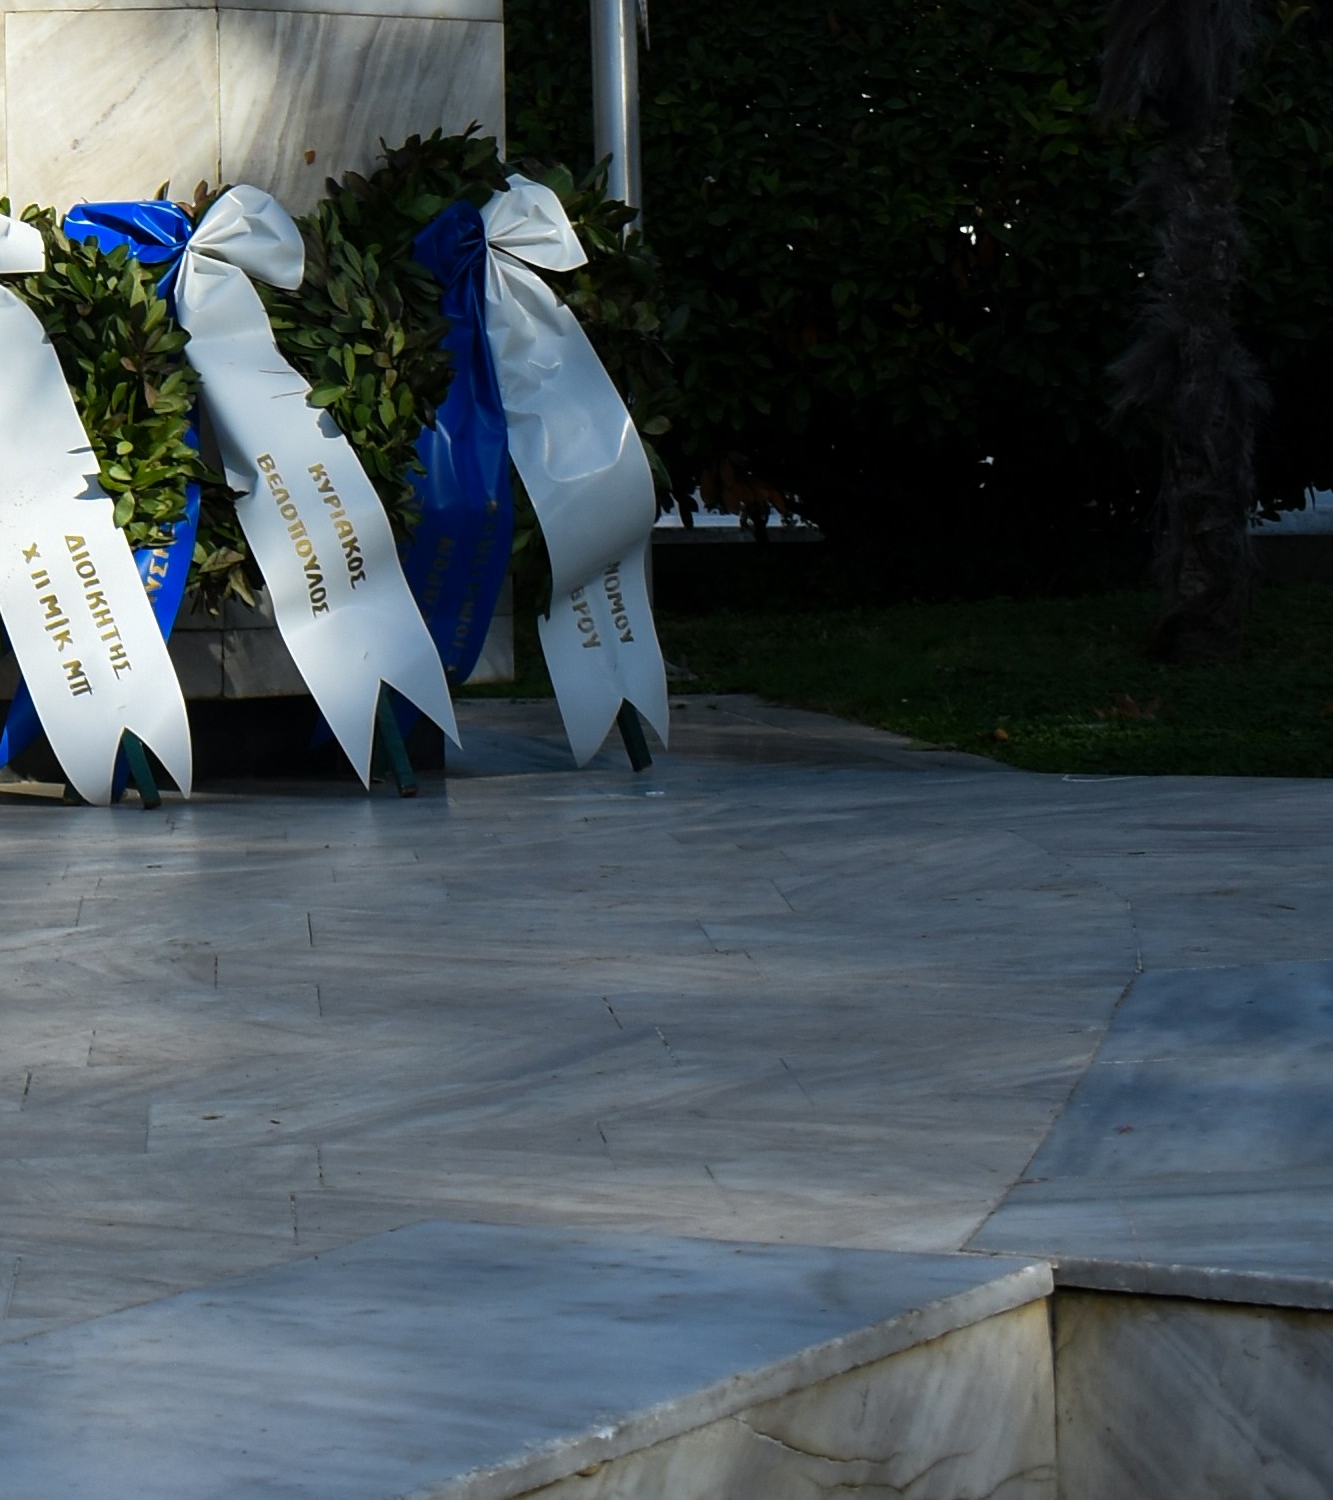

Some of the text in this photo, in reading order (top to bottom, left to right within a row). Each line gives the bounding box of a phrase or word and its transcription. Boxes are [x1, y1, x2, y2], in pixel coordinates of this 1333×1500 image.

[256, 453, 330, 618] ΒΕΛΟΠΟΥΛΟΣ
[307, 463, 366, 590] ΚΥΡΙΑΚΟΣ
[64, 535, 132, 680] ΔΙΟΙΚΗΤΗΣ
[604, 560, 635, 643] ΝΟΜΟΥ
